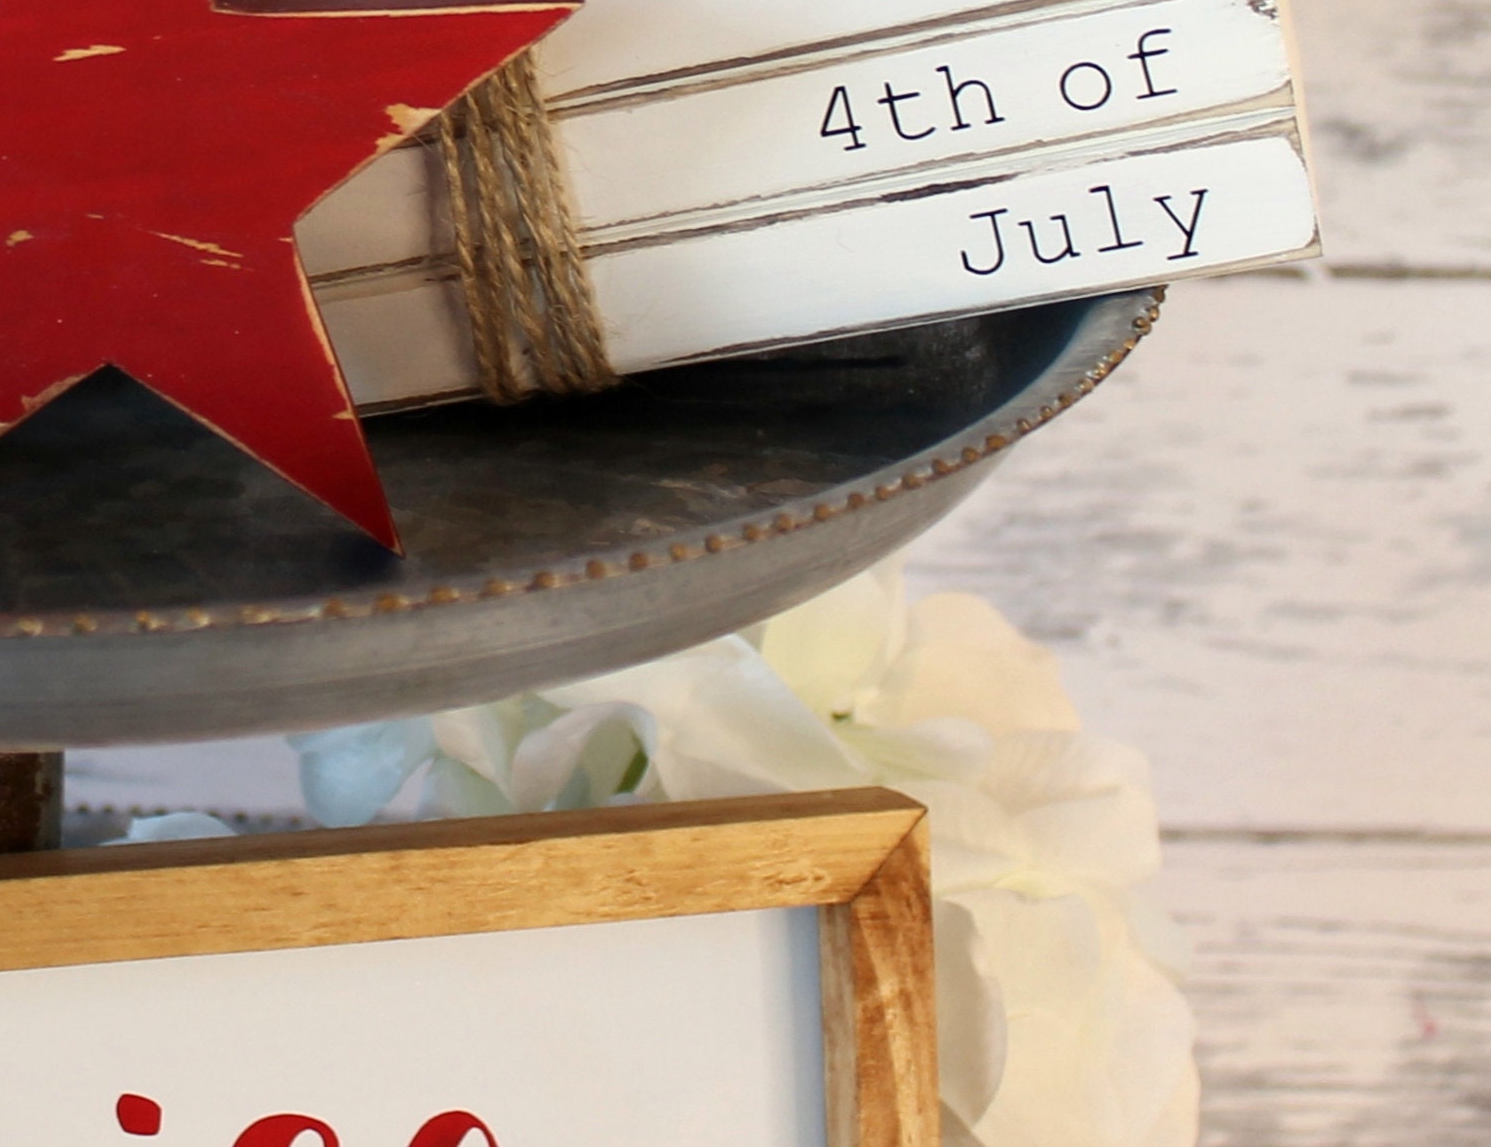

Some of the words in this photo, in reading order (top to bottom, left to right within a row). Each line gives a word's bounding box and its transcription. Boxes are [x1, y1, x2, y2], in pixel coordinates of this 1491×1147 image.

[819, 65, 1005, 151] 4th
[1059, 28, 1178, 111] of
[960, 187, 1209, 276] July
